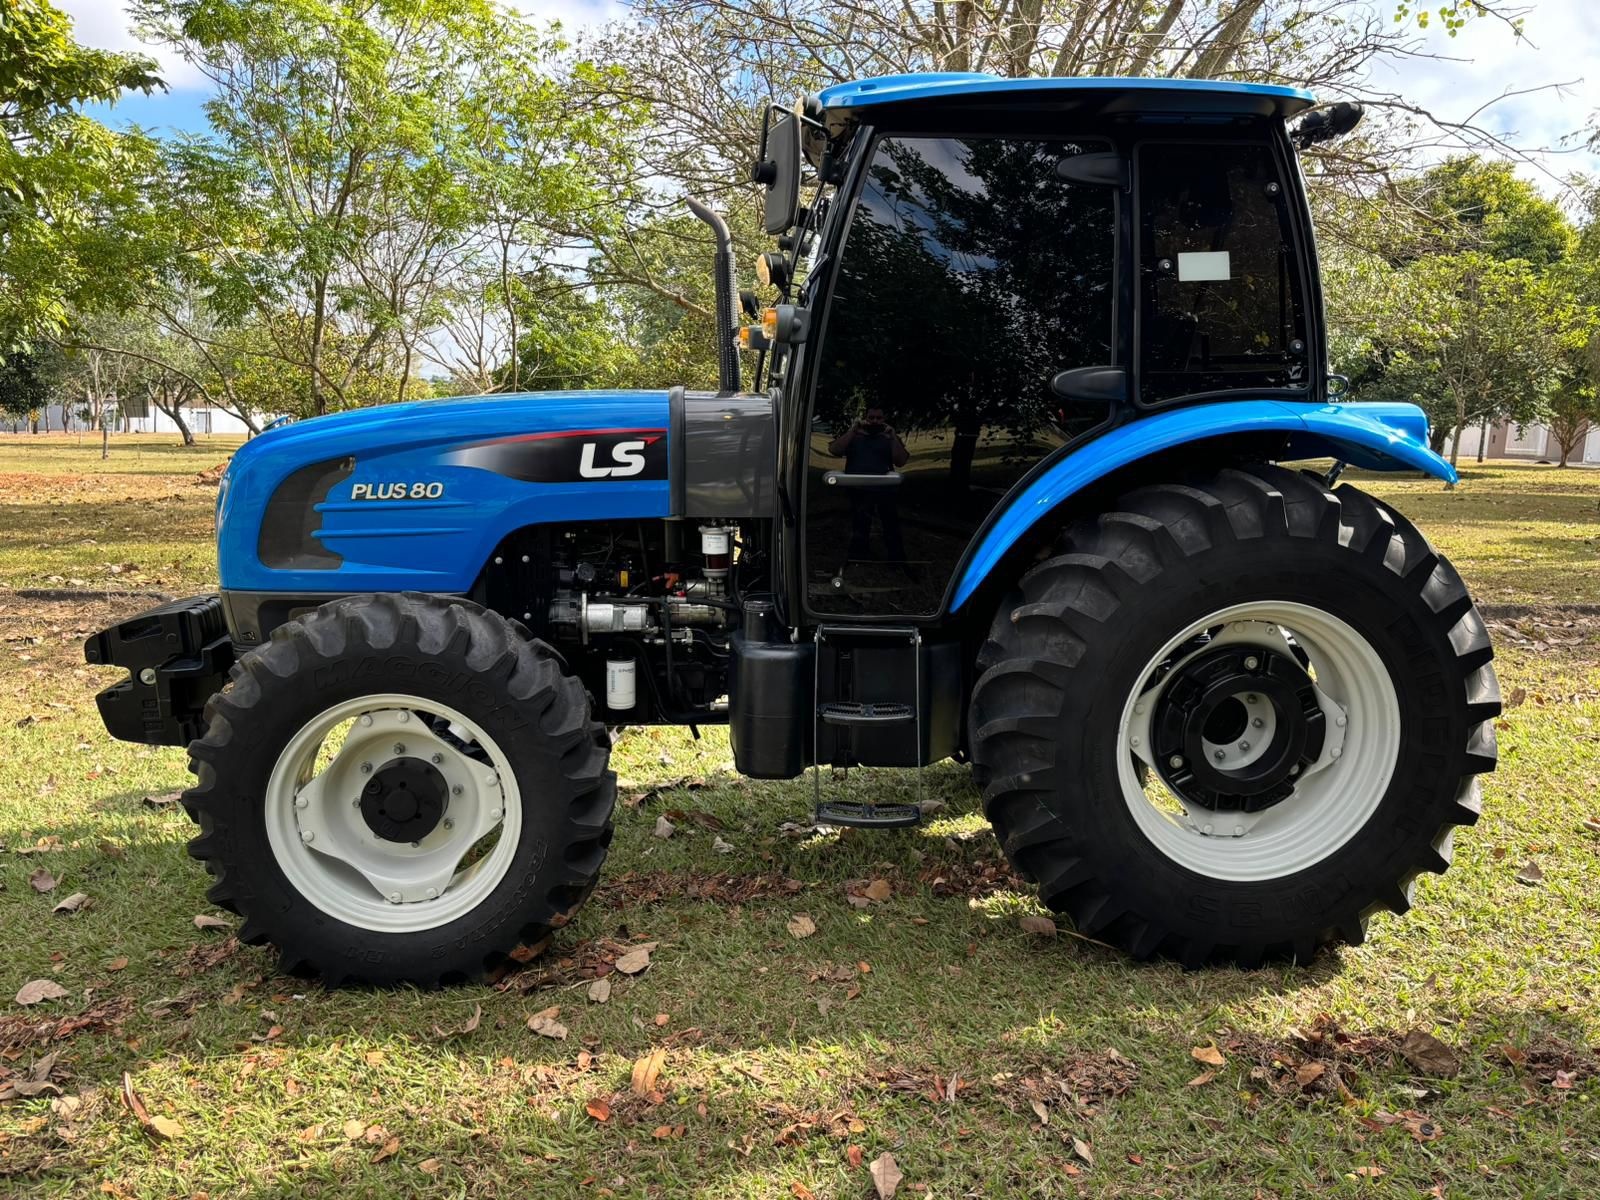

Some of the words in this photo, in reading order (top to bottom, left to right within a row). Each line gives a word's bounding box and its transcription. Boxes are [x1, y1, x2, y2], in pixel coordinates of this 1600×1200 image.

[579, 440, 646, 479] LS
[351, 482, 407, 500] PLUS
[409, 482, 444, 499] 80
[316, 656, 528, 731] MAGGION
